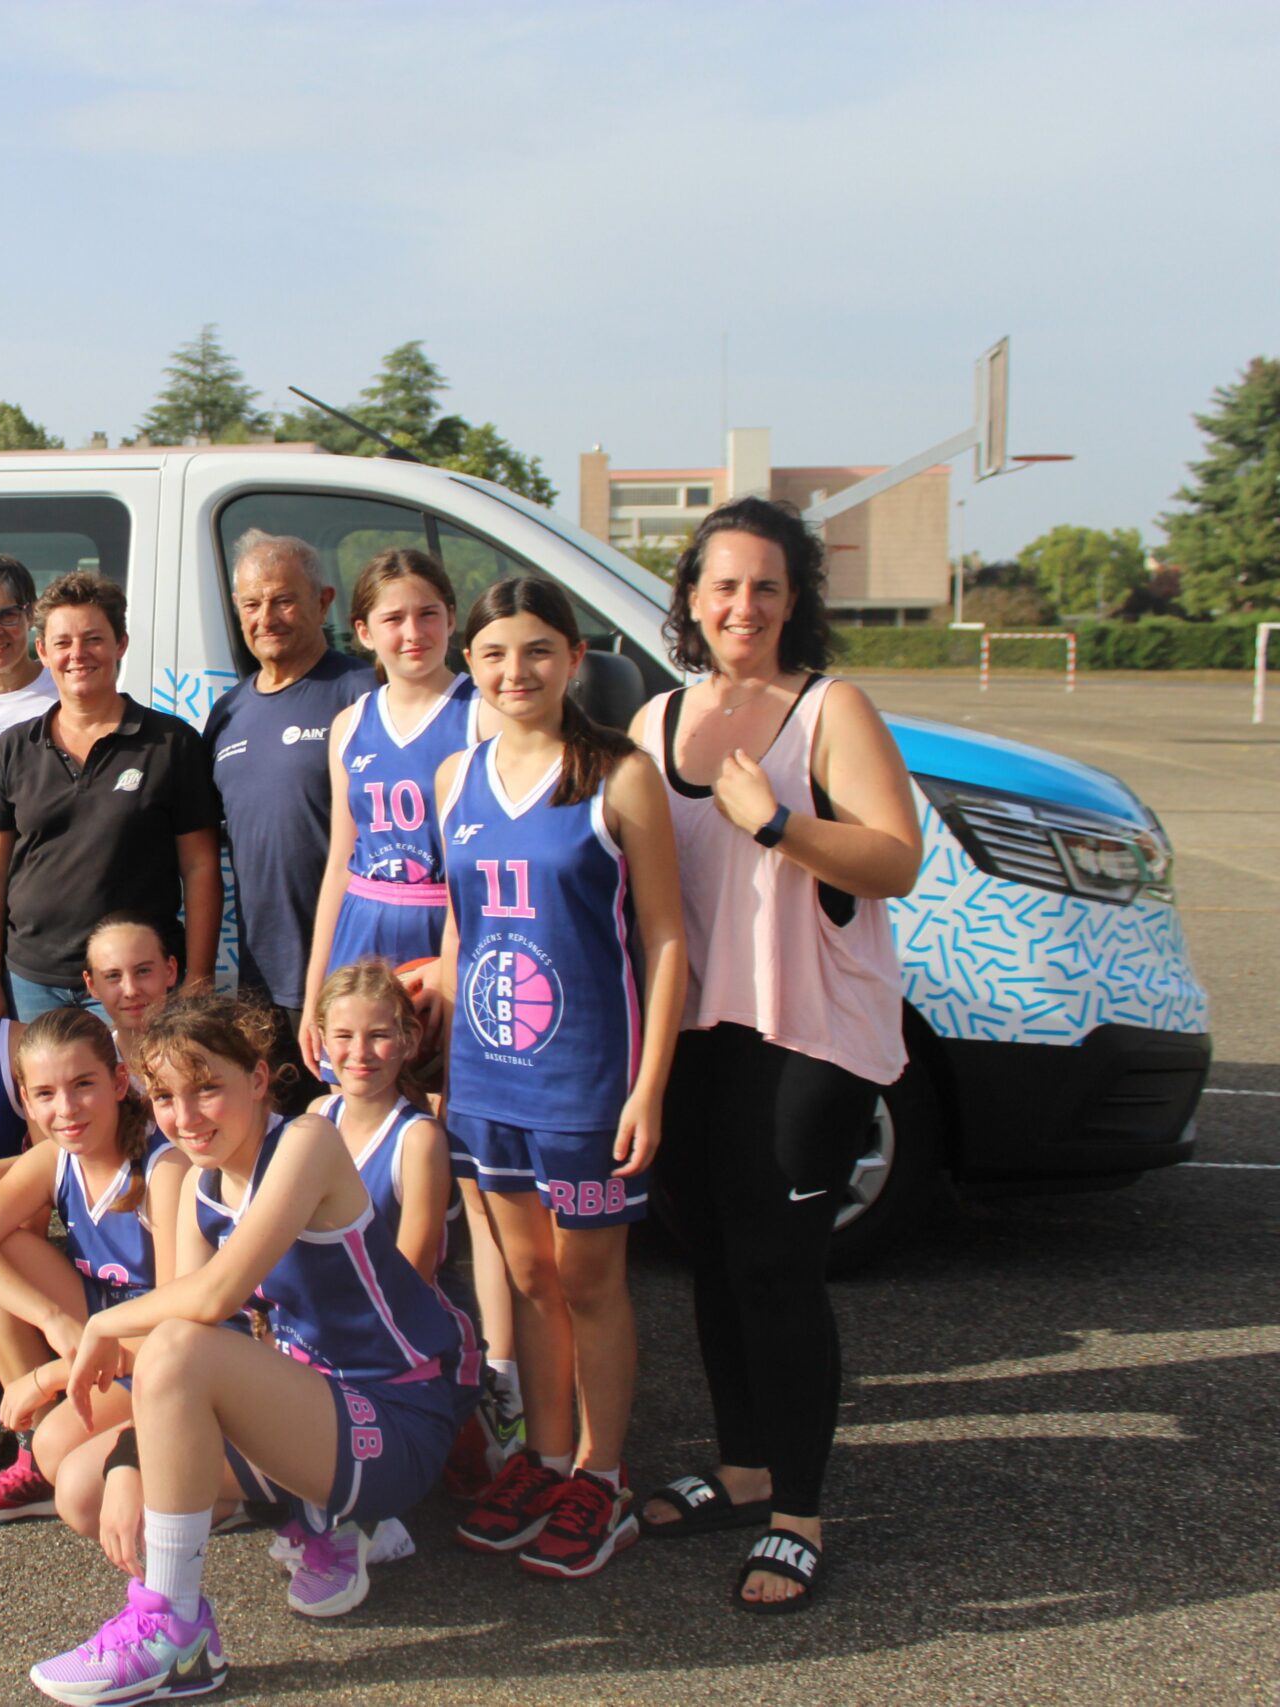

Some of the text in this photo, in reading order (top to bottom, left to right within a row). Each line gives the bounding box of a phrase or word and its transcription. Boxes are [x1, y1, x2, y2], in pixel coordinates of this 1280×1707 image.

[364, 779, 425, 833] 10
[476, 860, 536, 919] 11
[508, 932, 552, 966] REPLONGES
[484, 1052, 534, 1067] BASKETBALL
[337, 1380, 384, 1461] BB
